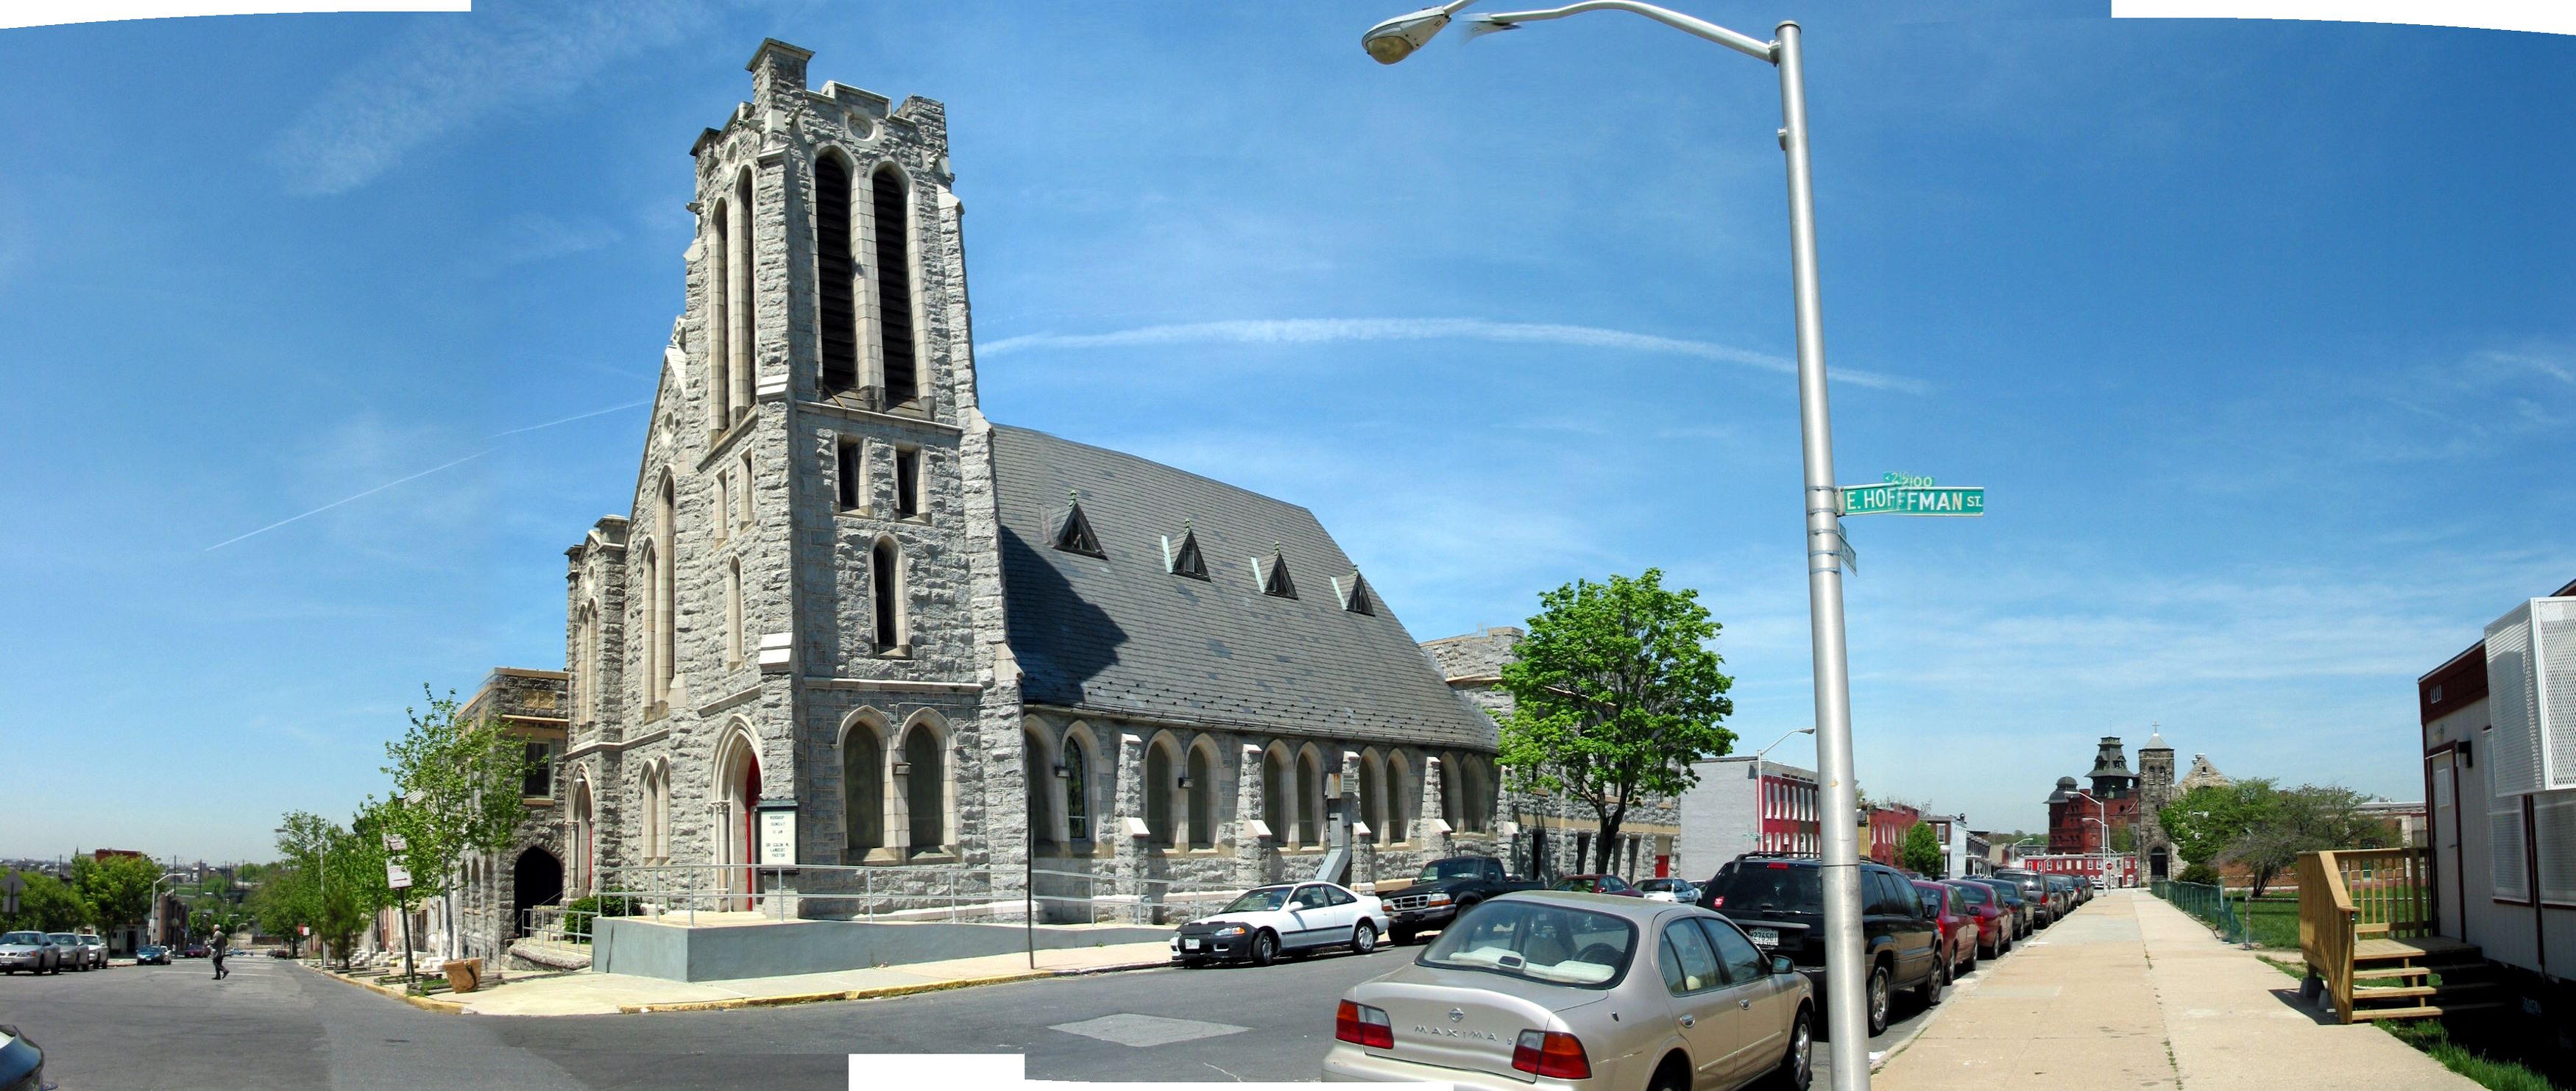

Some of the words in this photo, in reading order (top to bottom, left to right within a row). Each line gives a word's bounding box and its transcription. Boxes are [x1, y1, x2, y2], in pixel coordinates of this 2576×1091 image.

[1847, 491, 1861, 510] E.
[1967, 496, 1983, 507] ST.
[1415, 1025, 1497, 1041] MAXIMA
